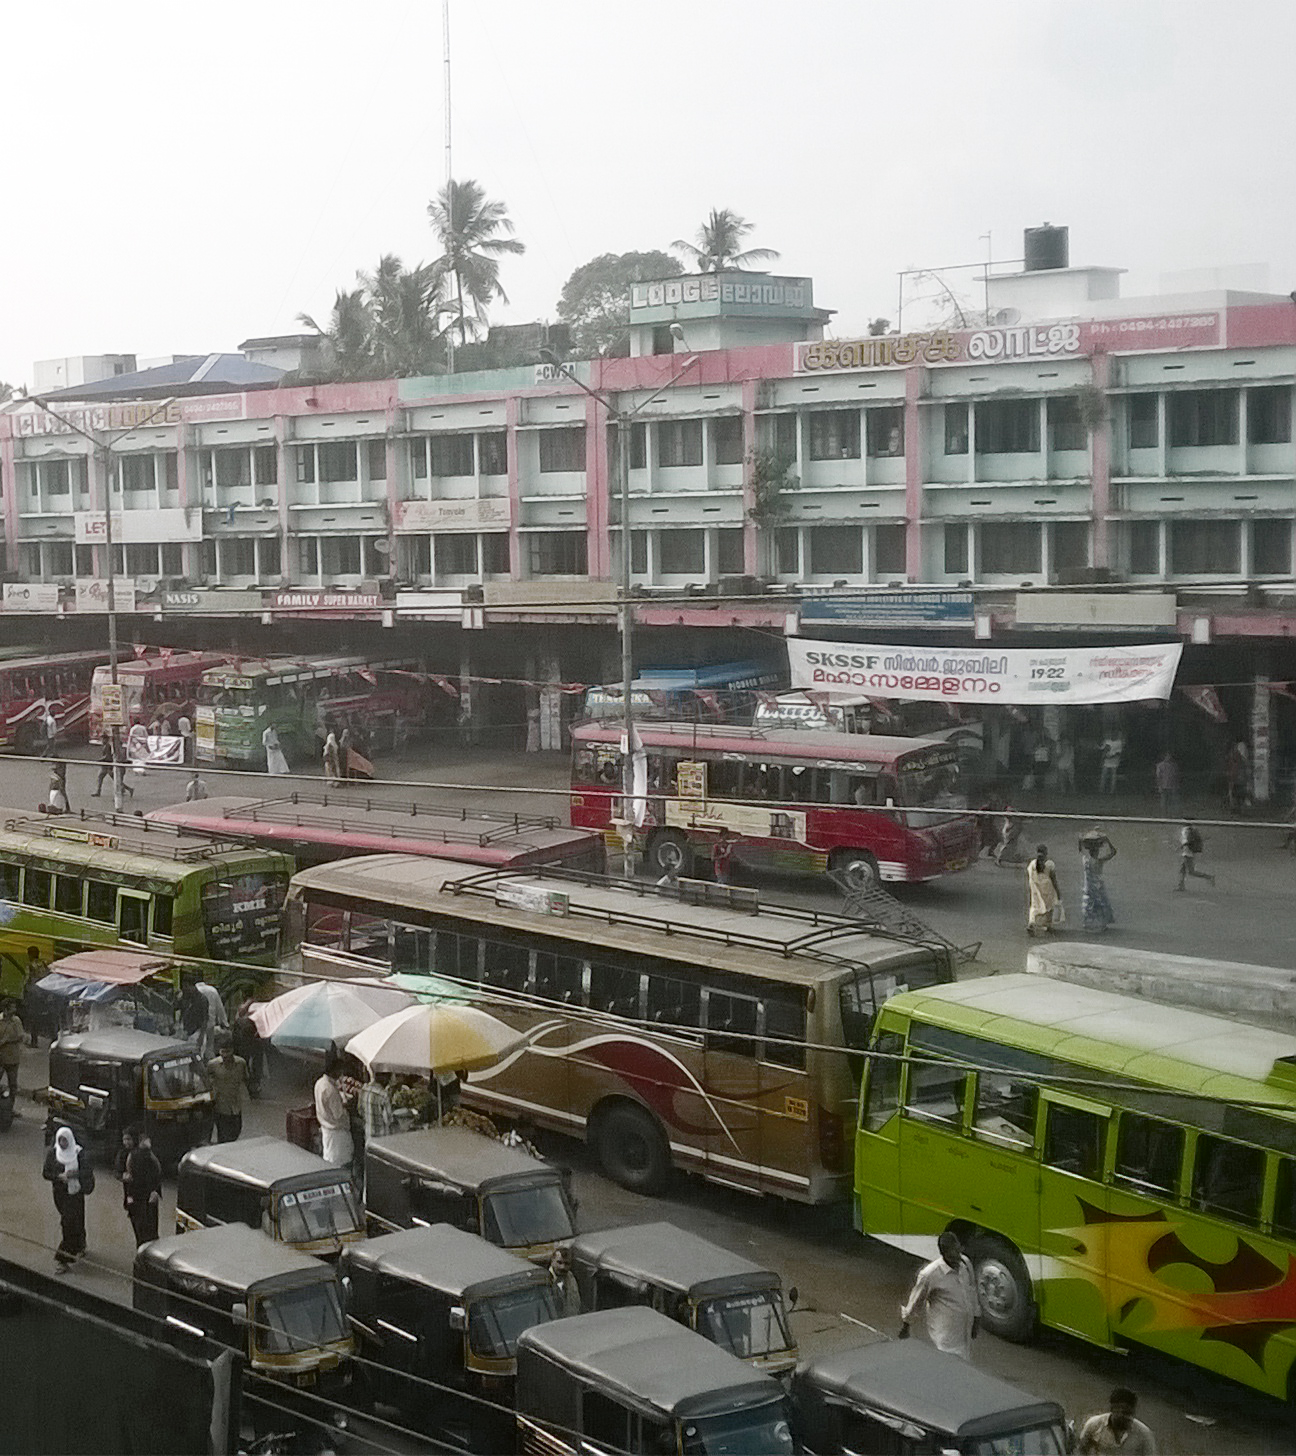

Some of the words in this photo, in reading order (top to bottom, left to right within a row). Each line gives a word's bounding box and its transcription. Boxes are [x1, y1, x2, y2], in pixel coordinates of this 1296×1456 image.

[631, 278, 719, 309] LODGE
[109, 402, 182, 427] LODGE
[166, 593, 199, 604] NASIS
[276, 594, 320, 605] FAMILY
[323, 595, 347, 605] SUPER
[347, 596, 378, 605] MARKET
[806, 651, 881, 669] SKSSF
